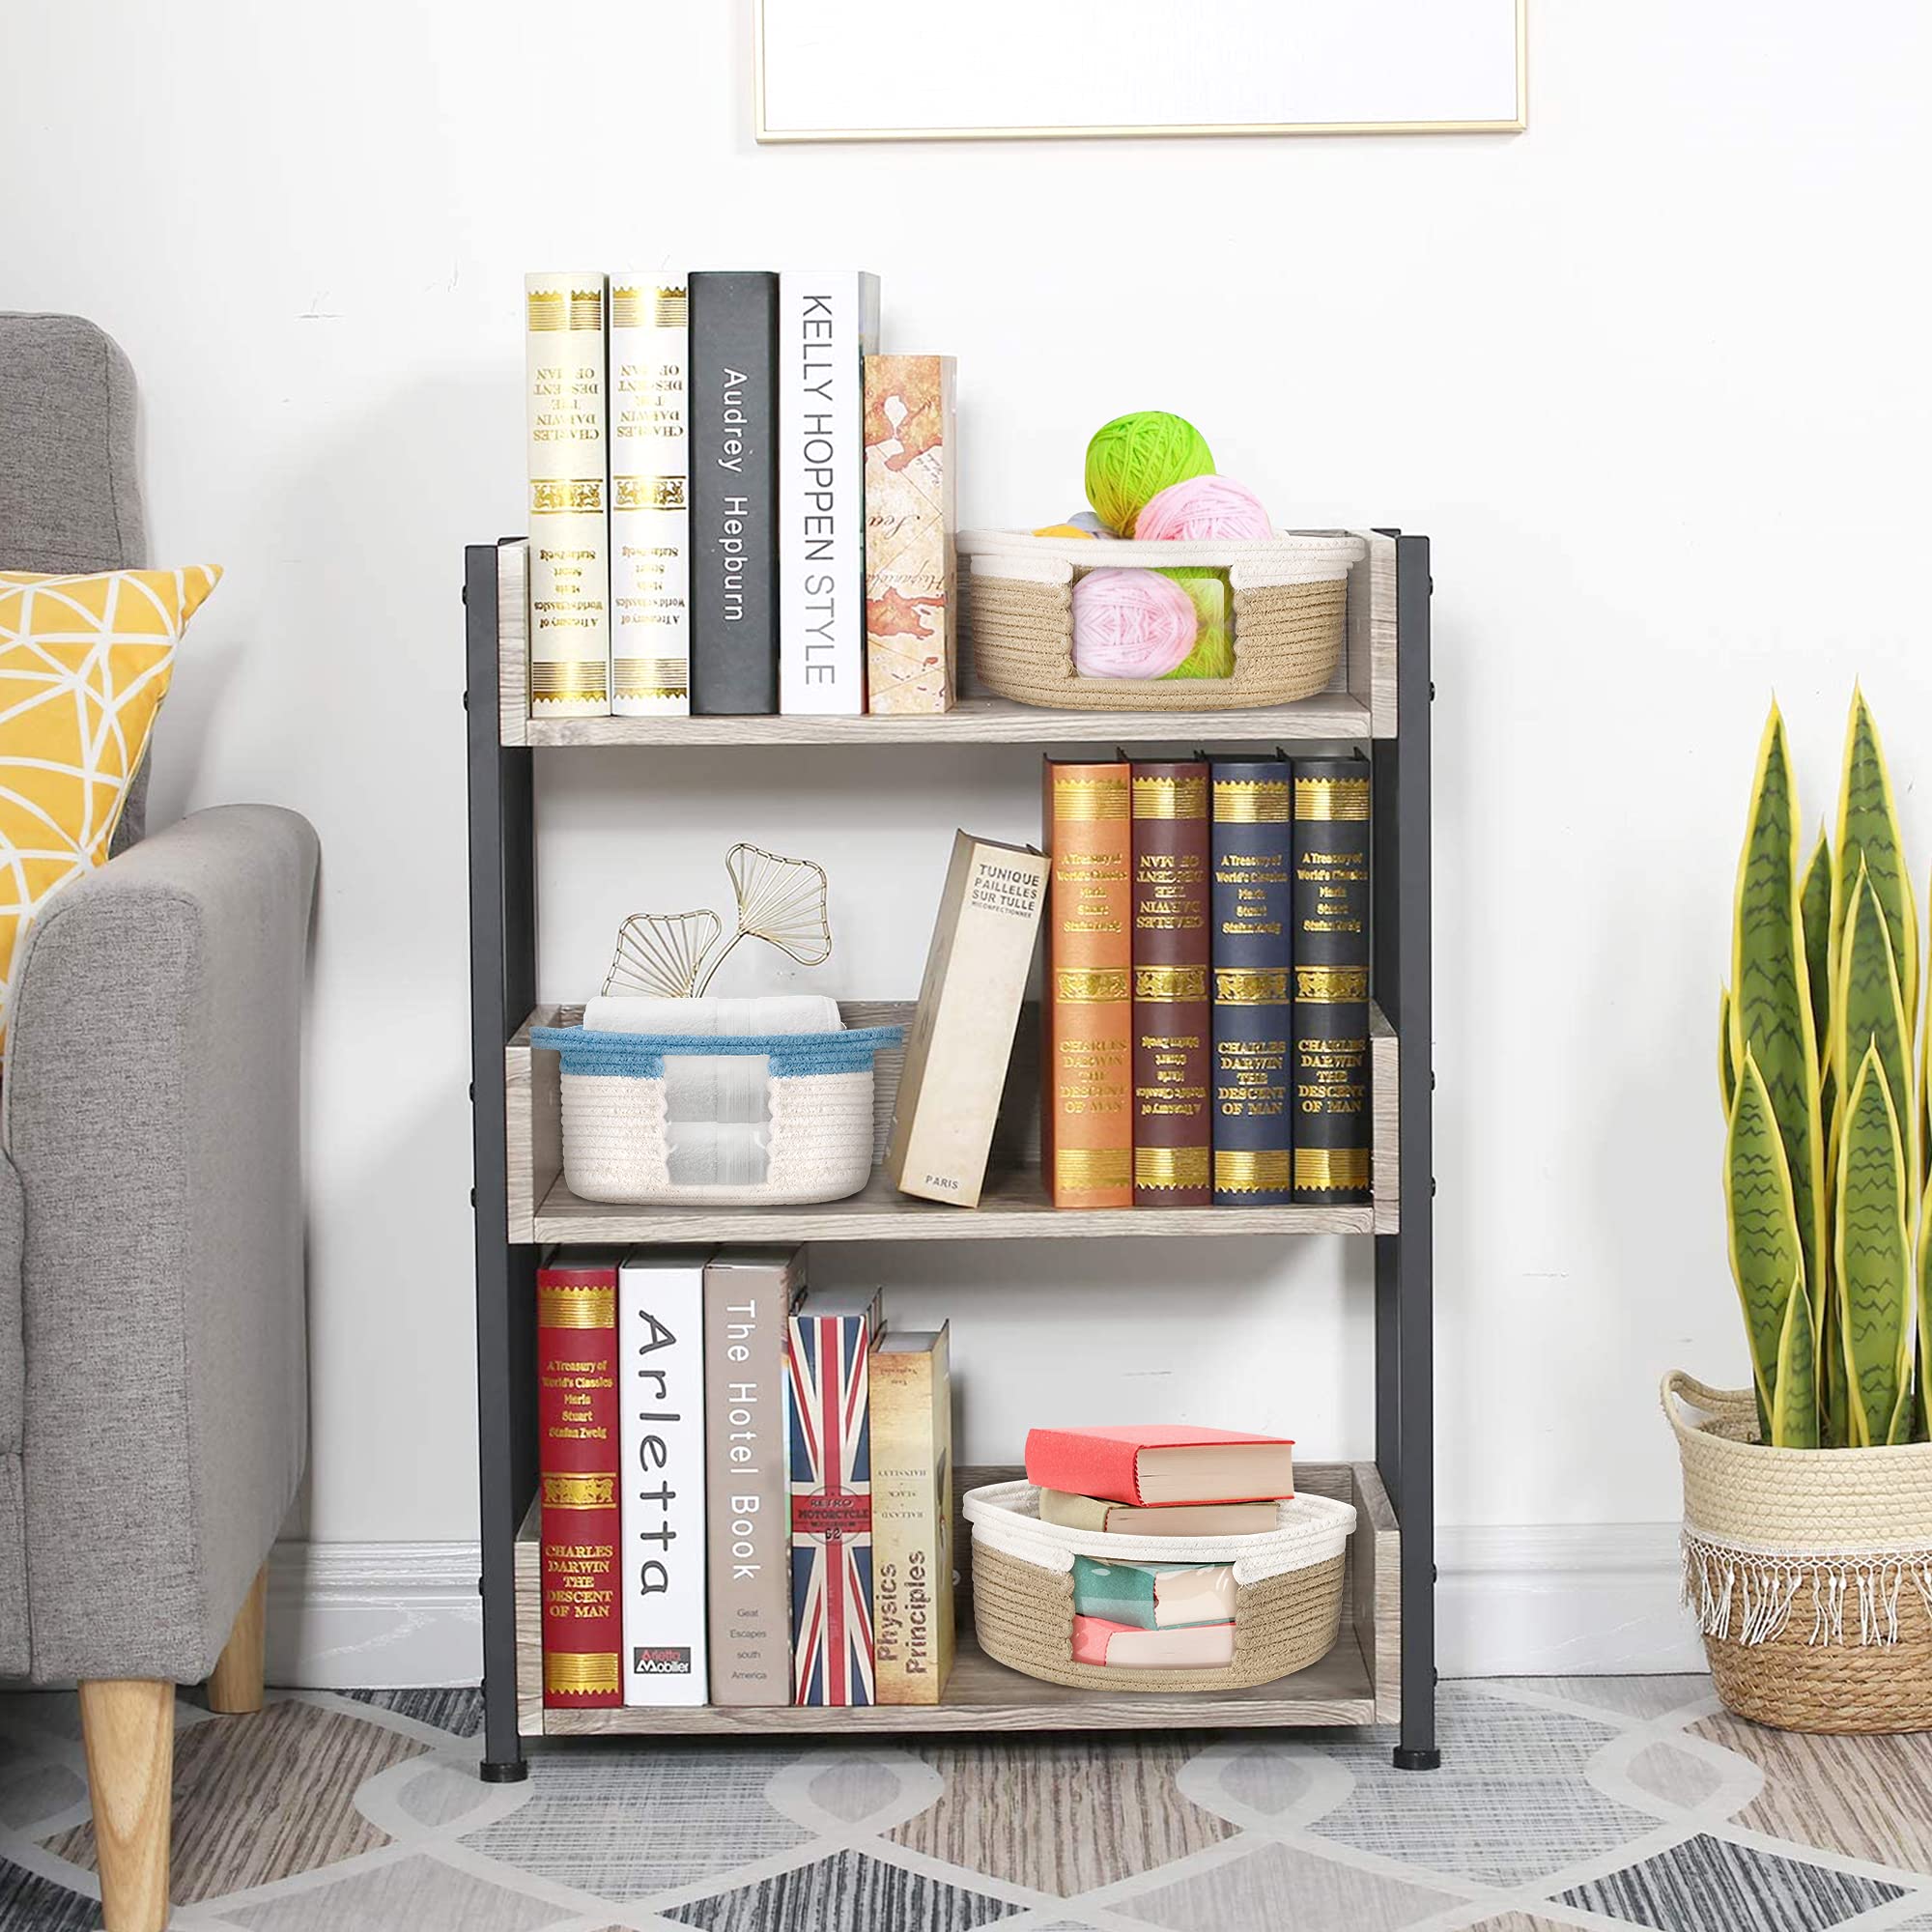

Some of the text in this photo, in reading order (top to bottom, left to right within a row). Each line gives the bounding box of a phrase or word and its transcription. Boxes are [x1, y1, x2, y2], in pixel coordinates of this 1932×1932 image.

[533, 384, 599, 395] DESENT
[616, 426, 684, 438] CHALES
[718, 368, 749, 621] Audrey Hepburn
[803, 296, 836, 685] KELLY HOPPEN STYLE
[1140, 856, 1175, 867] MAN
[979, 864, 1040, 887] TUNIQUE
[974, 877, 1037, 899] PAILLELES
[972, 890, 1036, 911] SUR TULLE
[1218, 1041, 1286, 1054] CHARLES
[1221, 1057, 1283, 1069] DARWIN
[1218, 1088, 1286, 1100] DESCENT
[1221, 1102, 1283, 1115] OF MAN
[1302, 1100, 1361, 1113] OF MAN
[925, 1175, 958, 1189] PARIS
[597, 1360, 608, 1371] of
[726, 1299, 761, 1579] The Hotel Book
[639, 1310, 680, 1596] Arletta
[545, 1545, 613, 1557] CHARLES
[548, 1560, 611, 1573] DARWIN
[562, 1576, 595, 1588] THE
[547, 1590, 613, 1604] DESCENT
[549, 1605, 610, 1618] OF MAN
[876, 1564, 903, 1662] Physics
[904, 1550, 931, 1674] Principles
[729, 1629, 767, 1639] Escapes
[737, 1650, 761, 1660] south
[731, 1671, 767, 1680] America
